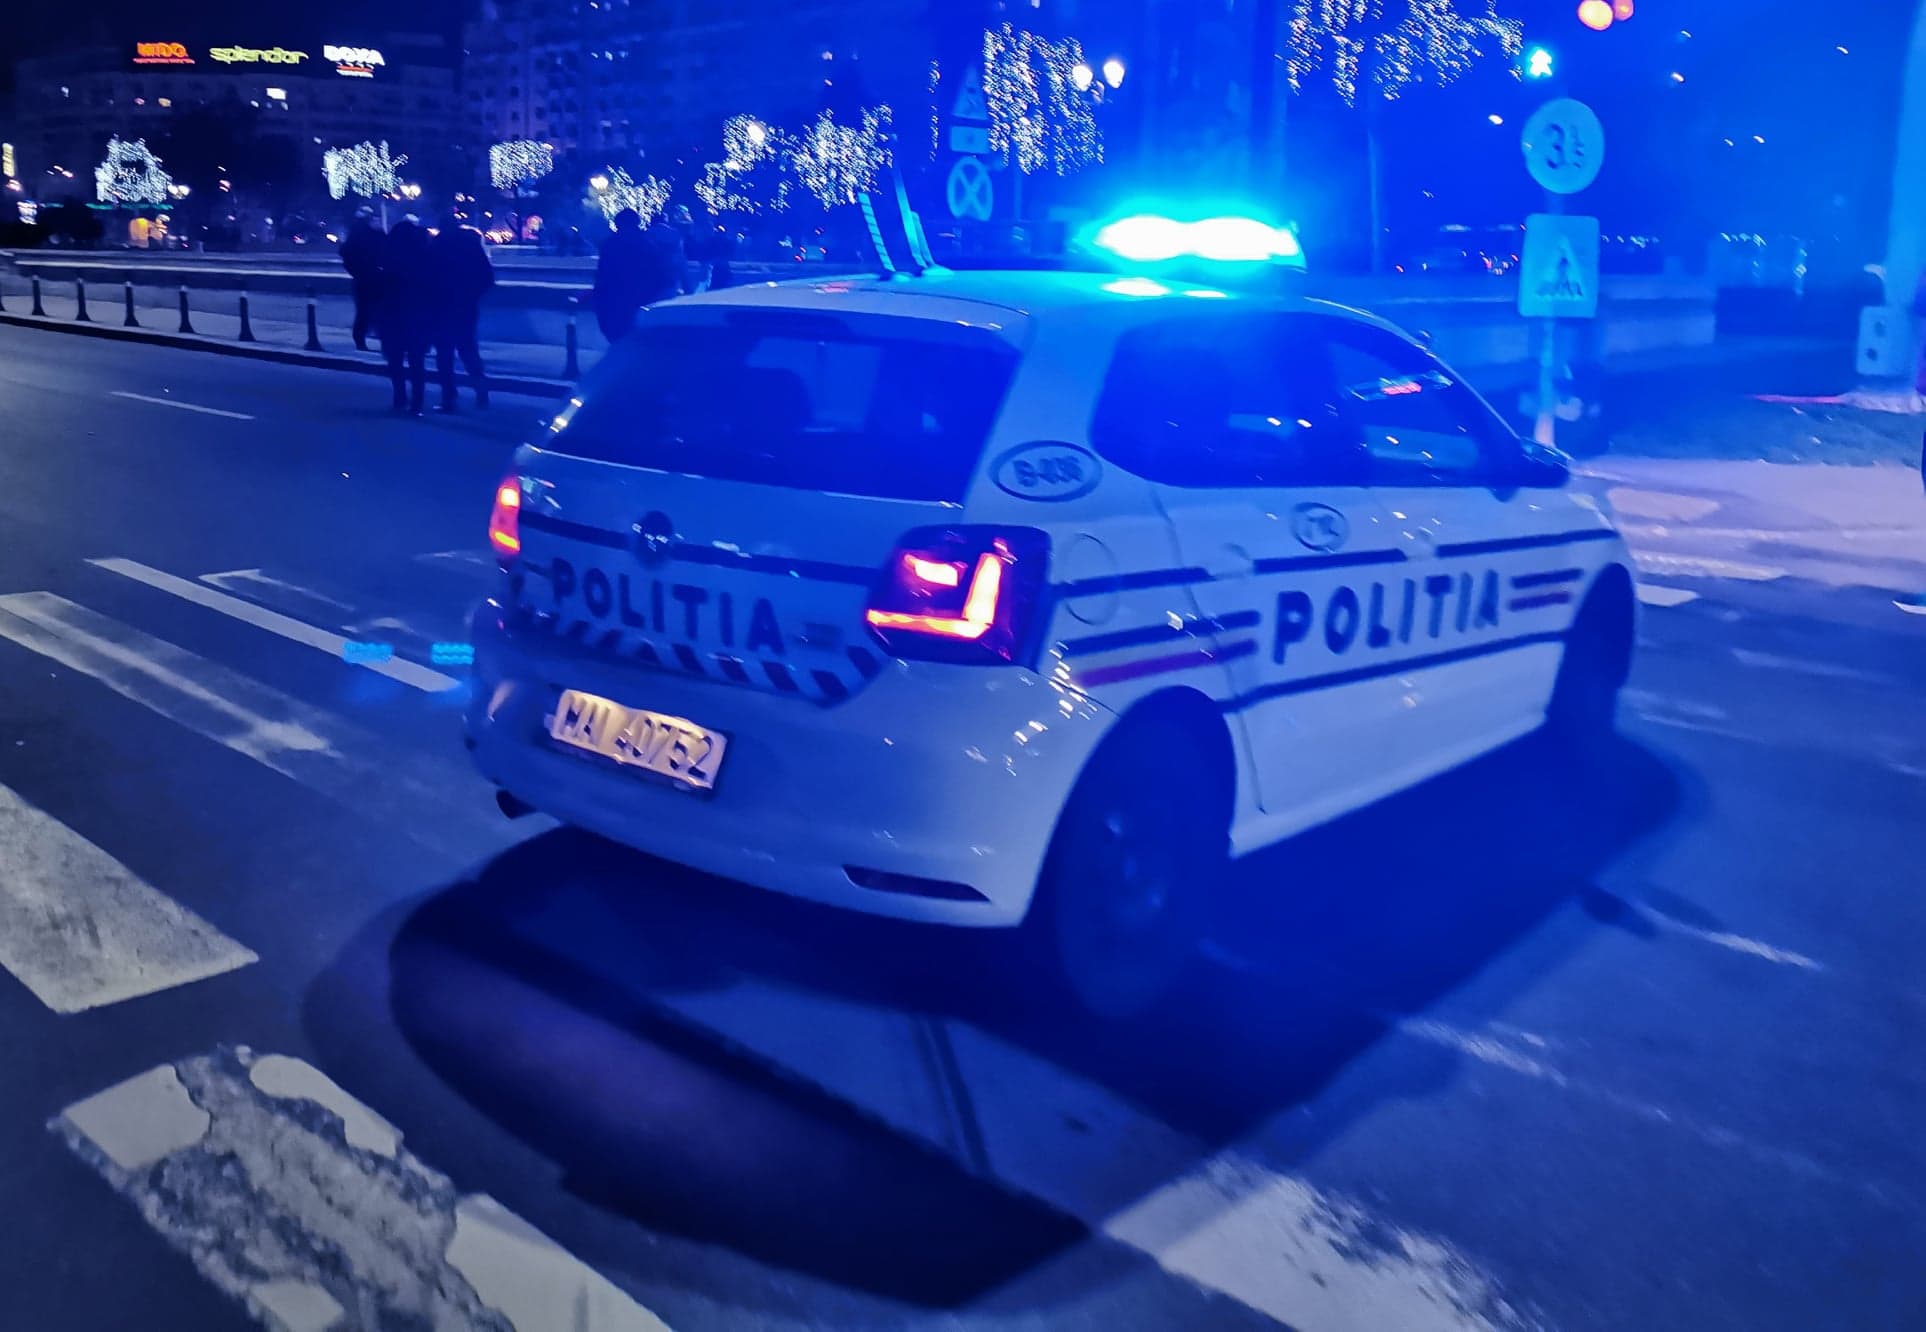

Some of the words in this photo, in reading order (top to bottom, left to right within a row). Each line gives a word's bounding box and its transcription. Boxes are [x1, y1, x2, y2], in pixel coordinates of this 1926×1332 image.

[209, 45, 309, 64] splendor
[551, 557, 786, 656] POLITIA
[1273, 568, 1499, 666] POLITIA
